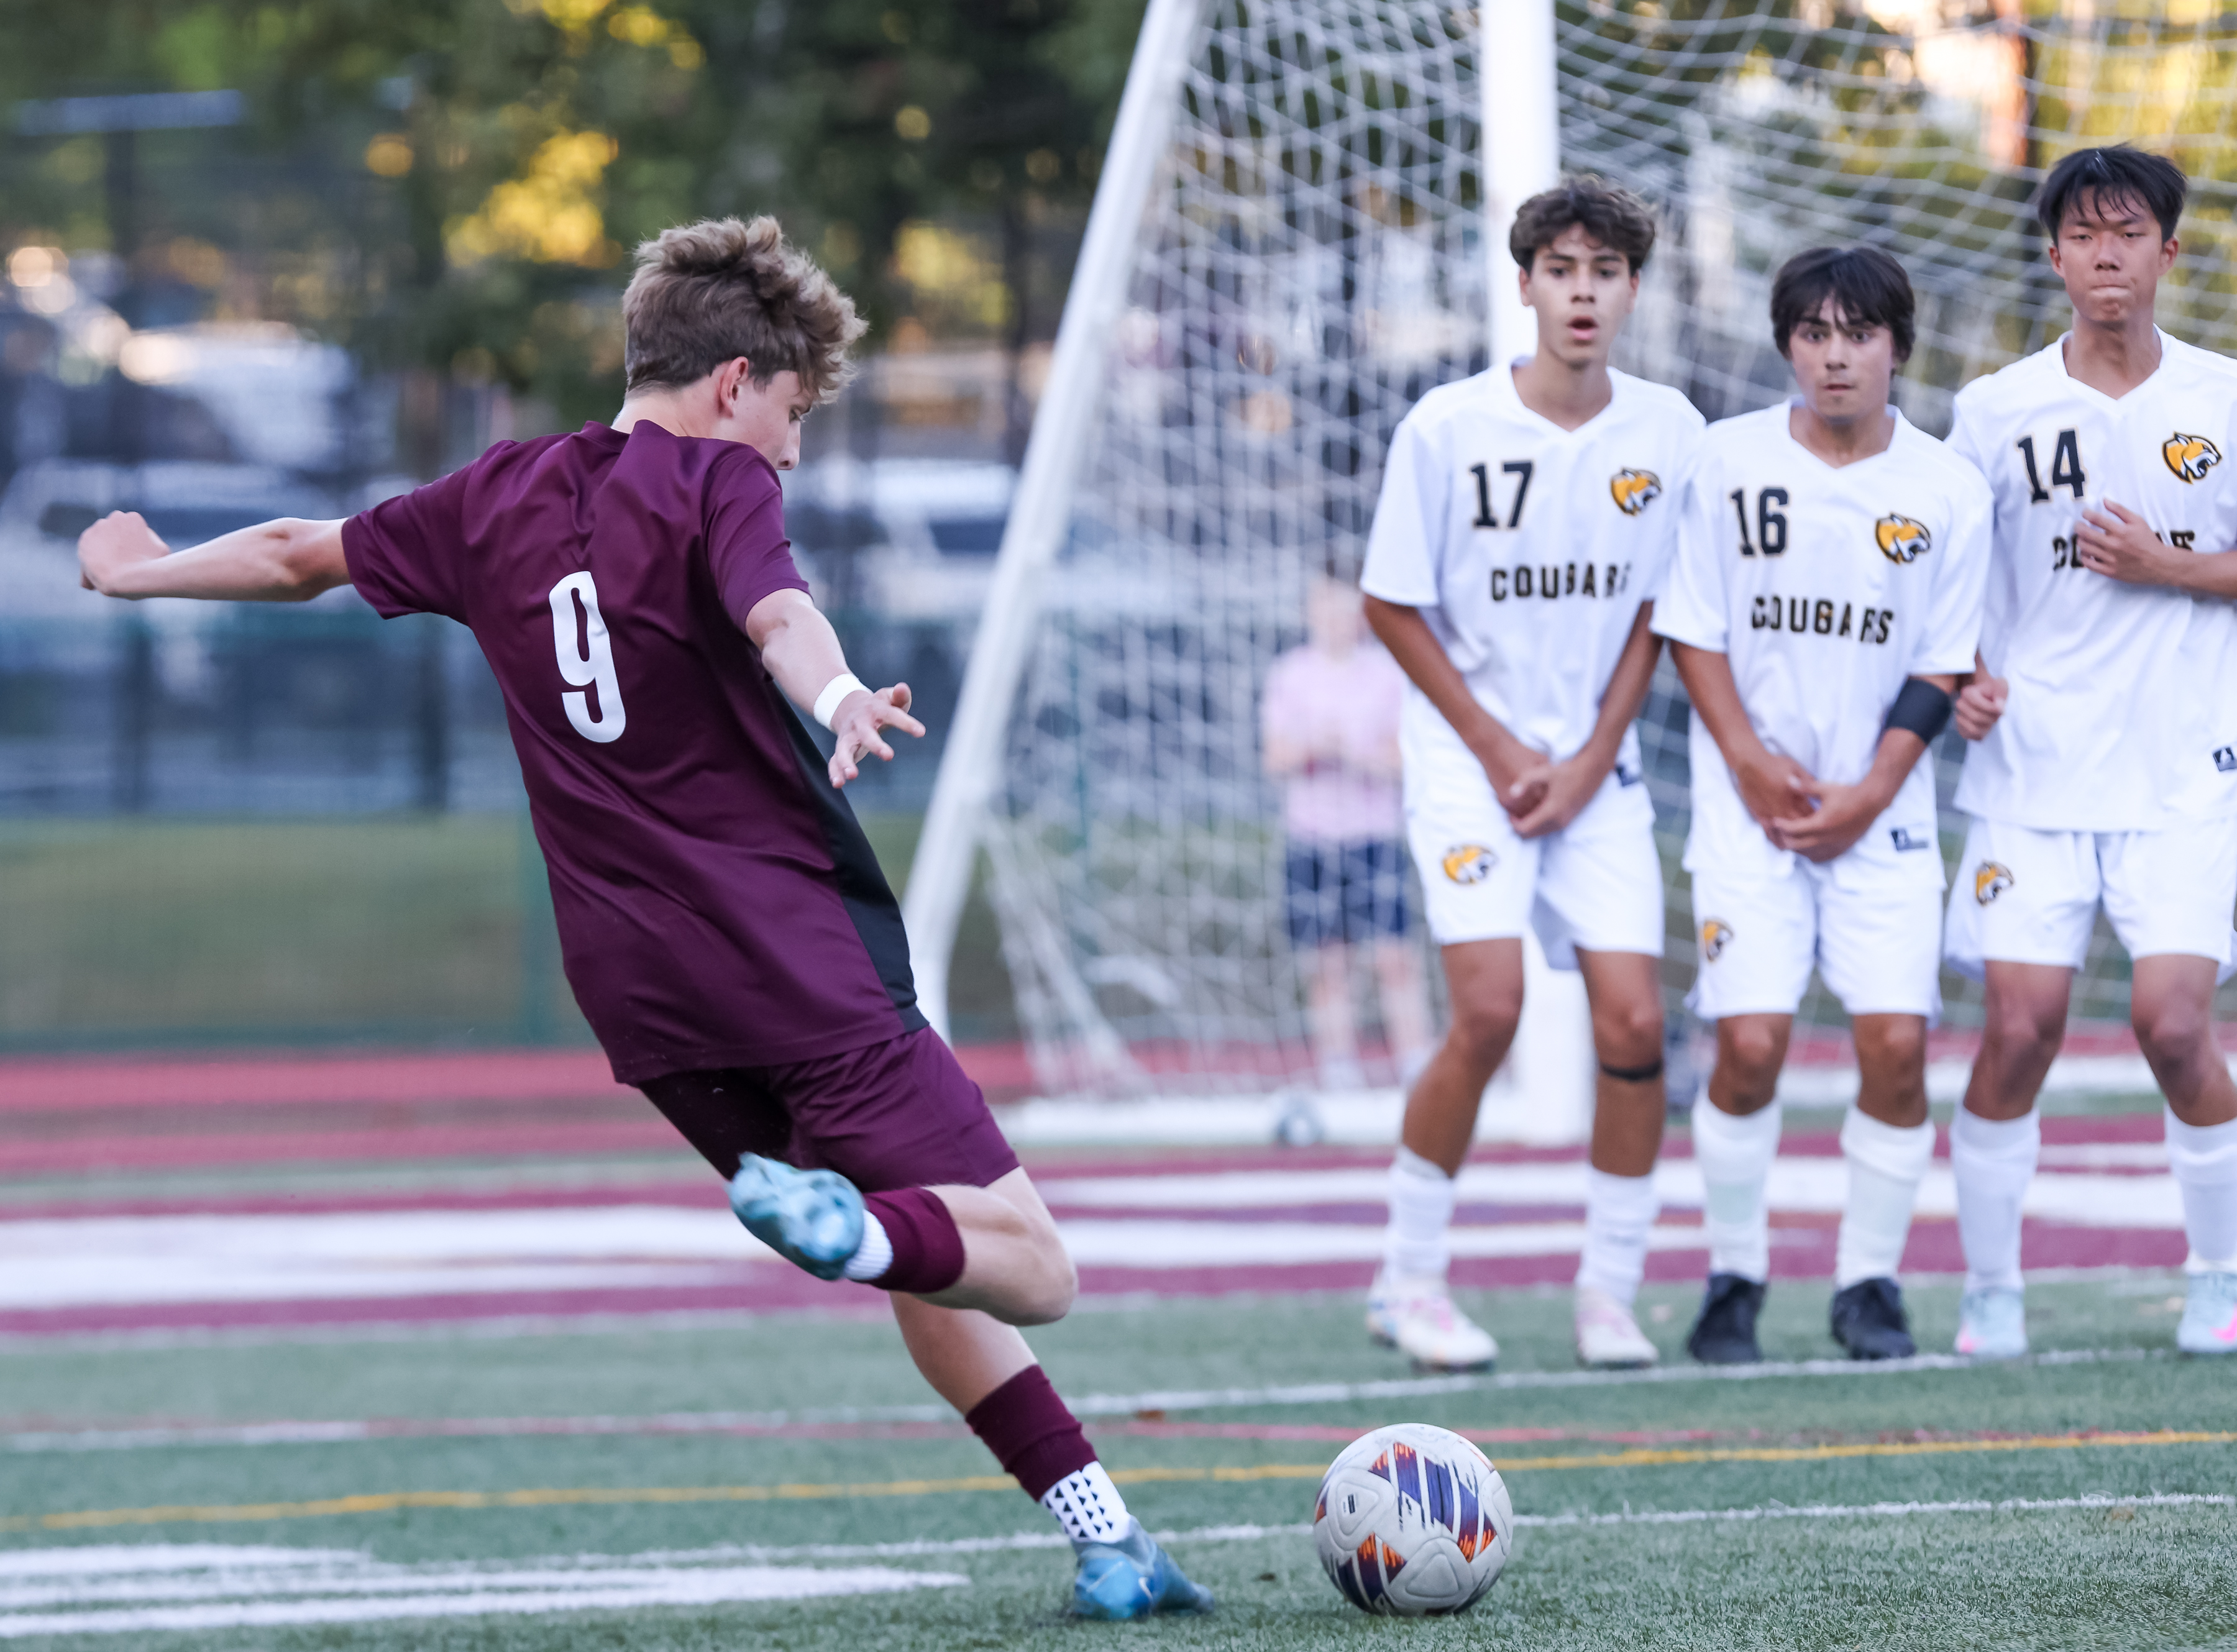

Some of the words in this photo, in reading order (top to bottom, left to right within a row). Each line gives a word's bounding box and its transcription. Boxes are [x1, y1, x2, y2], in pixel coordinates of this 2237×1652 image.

[1470, 460, 1534, 530] 17
[2016, 427, 2087, 505] 14
[1730, 487, 1789, 557] 16
[549, 570, 626, 743] 9
